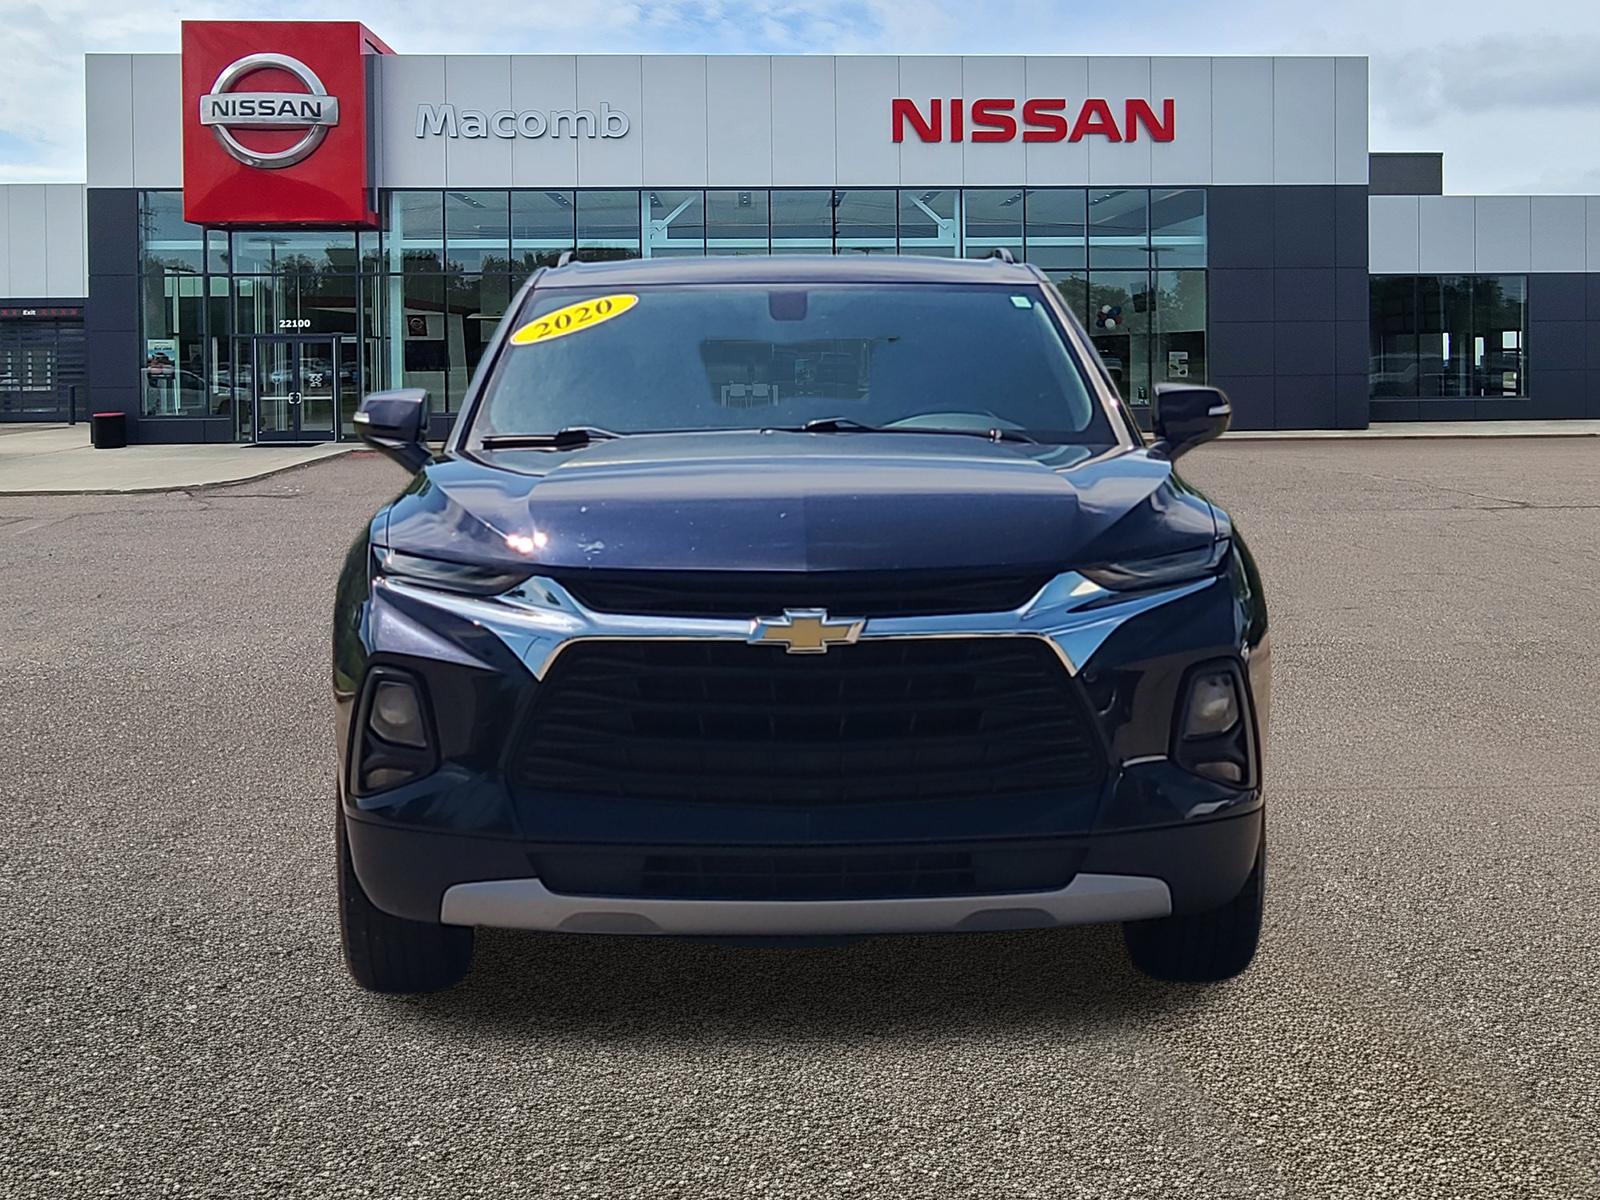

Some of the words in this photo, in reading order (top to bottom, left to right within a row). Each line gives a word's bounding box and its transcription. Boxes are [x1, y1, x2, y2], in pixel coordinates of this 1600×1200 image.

[211, 100, 322, 117] NISSAN
[415, 102, 630, 138] Macomb
[891, 98, 1176, 143] NISSAN
[279, 319, 311, 328] 22100
[533, 299, 613, 338] 2020
